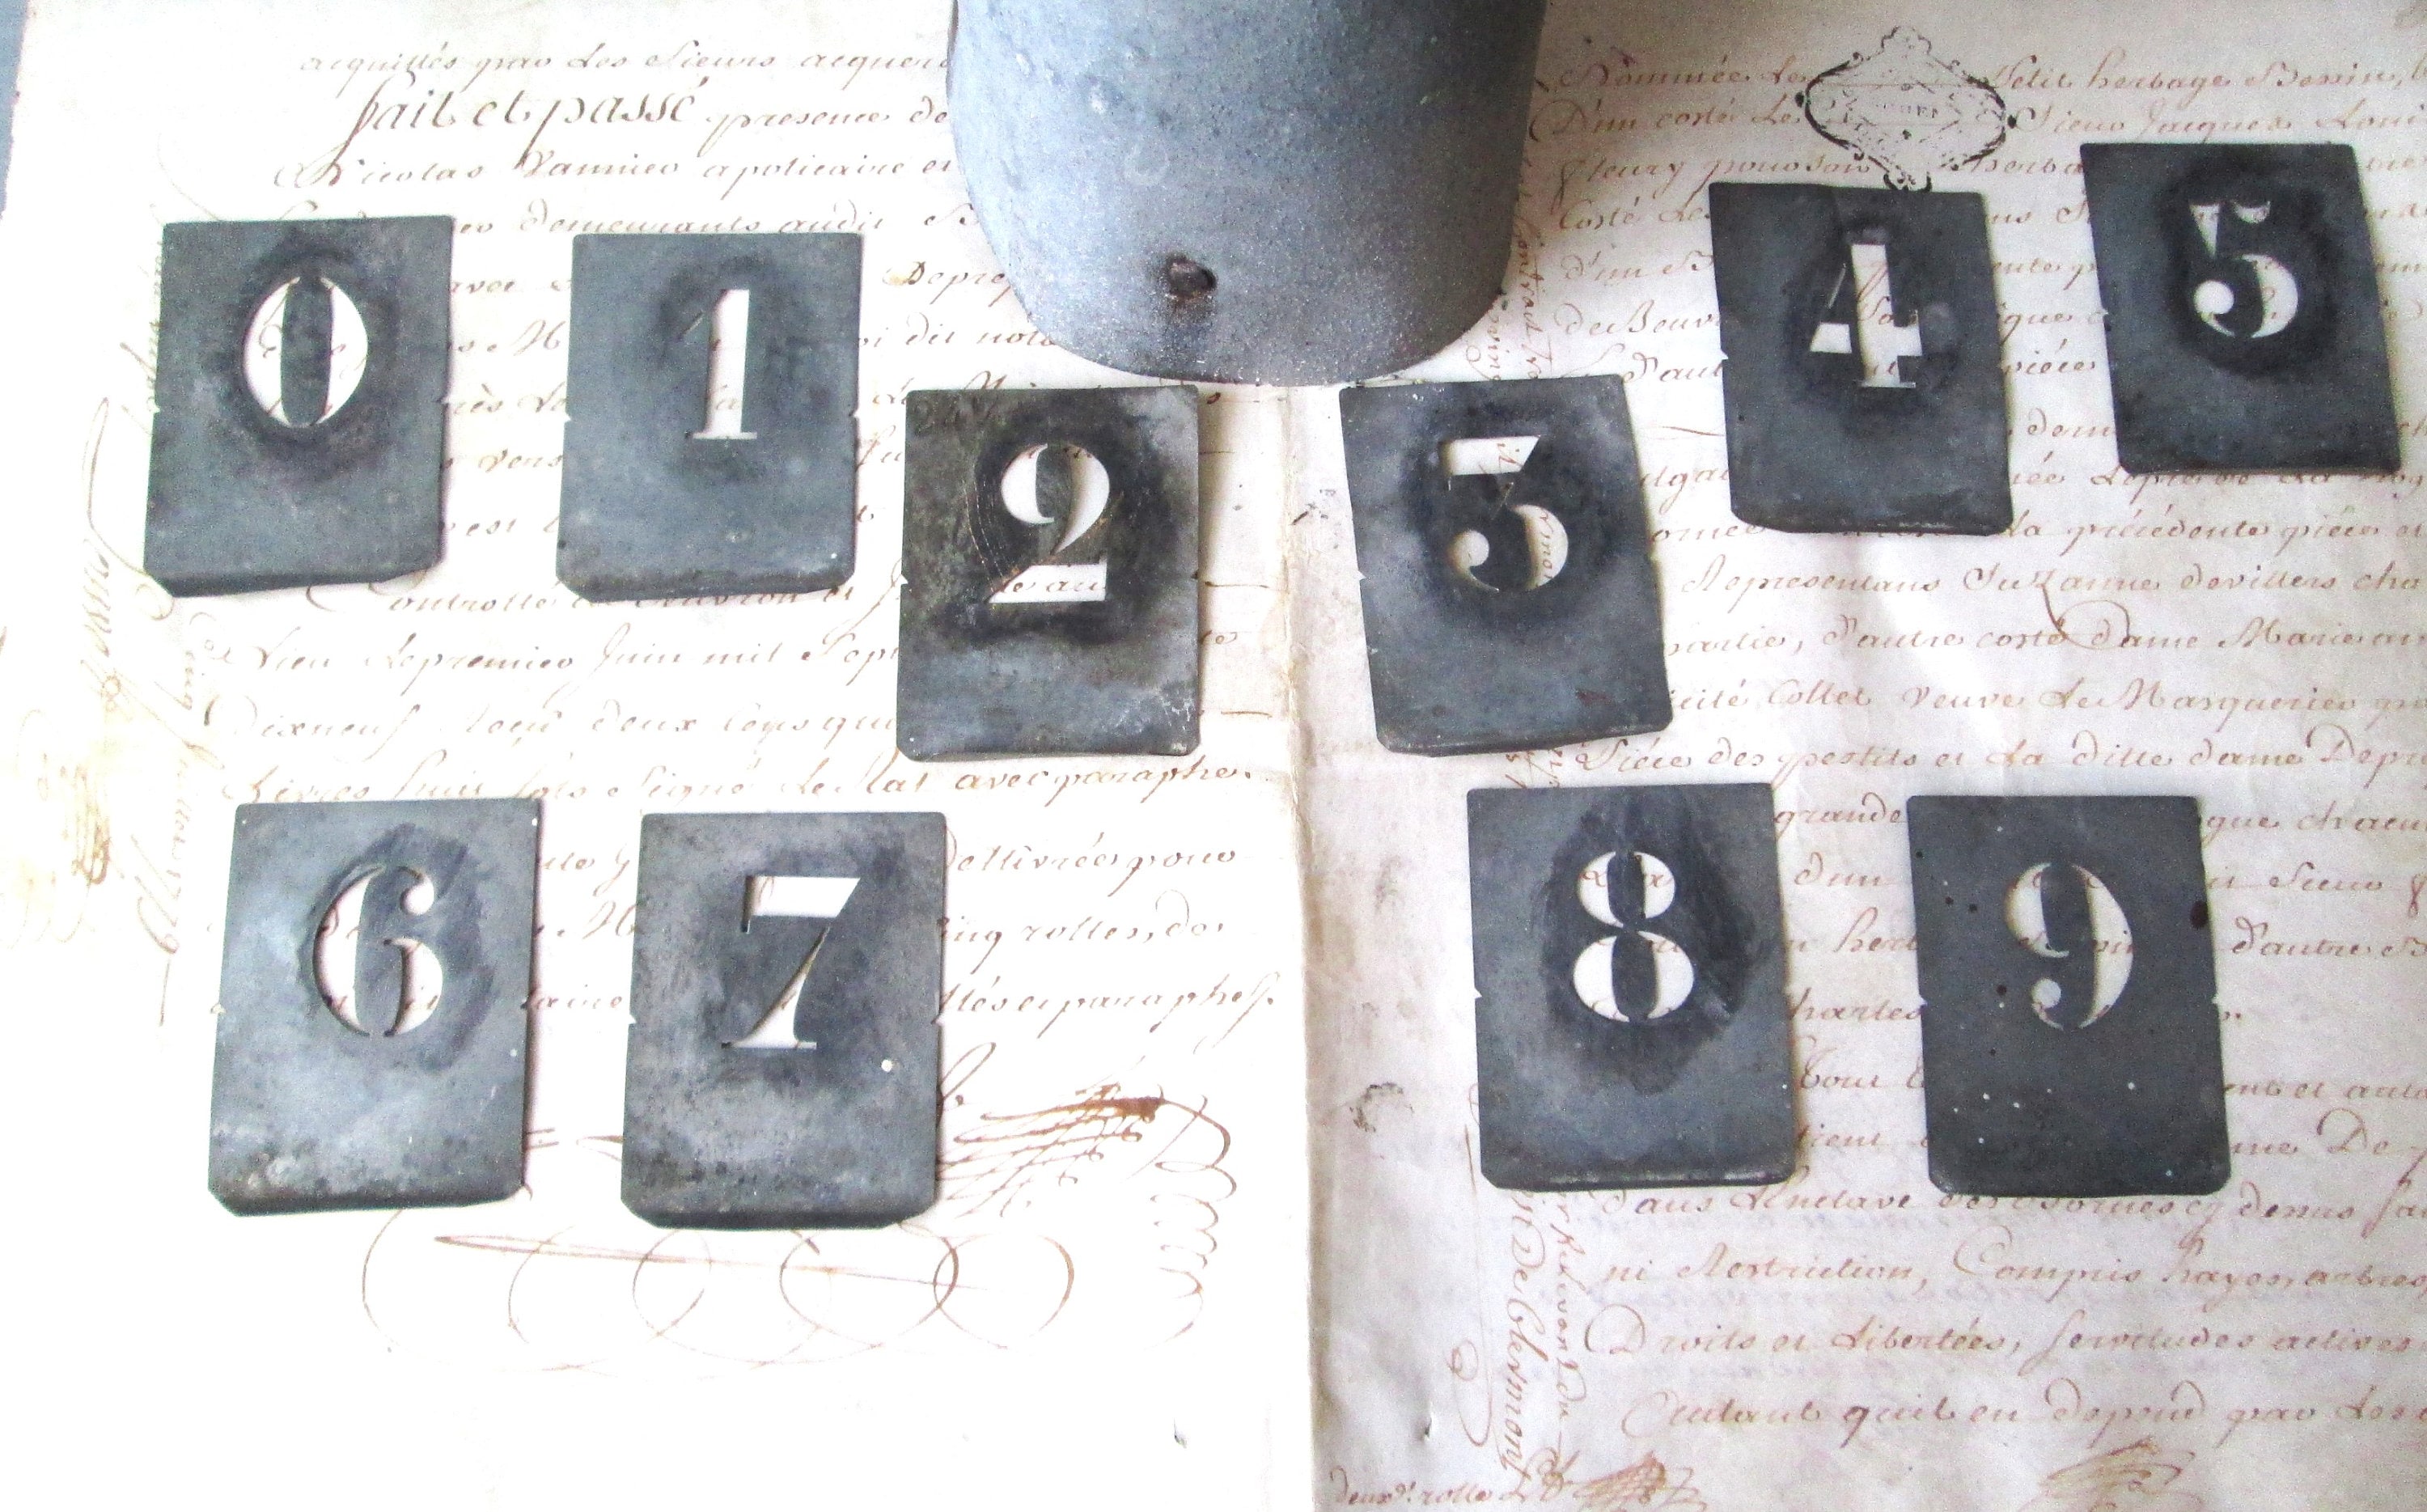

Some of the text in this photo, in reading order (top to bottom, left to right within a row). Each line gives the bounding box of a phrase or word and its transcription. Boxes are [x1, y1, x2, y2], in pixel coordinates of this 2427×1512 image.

[1810, 242, 1922, 388] 4
[2188, 201, 2299, 339] 5
[244, 276, 368, 427] 0
[682, 289, 757, 439] 1
[984, 443, 1110, 604] 2
[1438, 434, 1569, 593] 3
[312, 863, 444, 1037] 6
[722, 875, 861, 1049] 7
[1572, 850, 1695, 1023] 8
[2004, 862, 2134, 1031] 9
